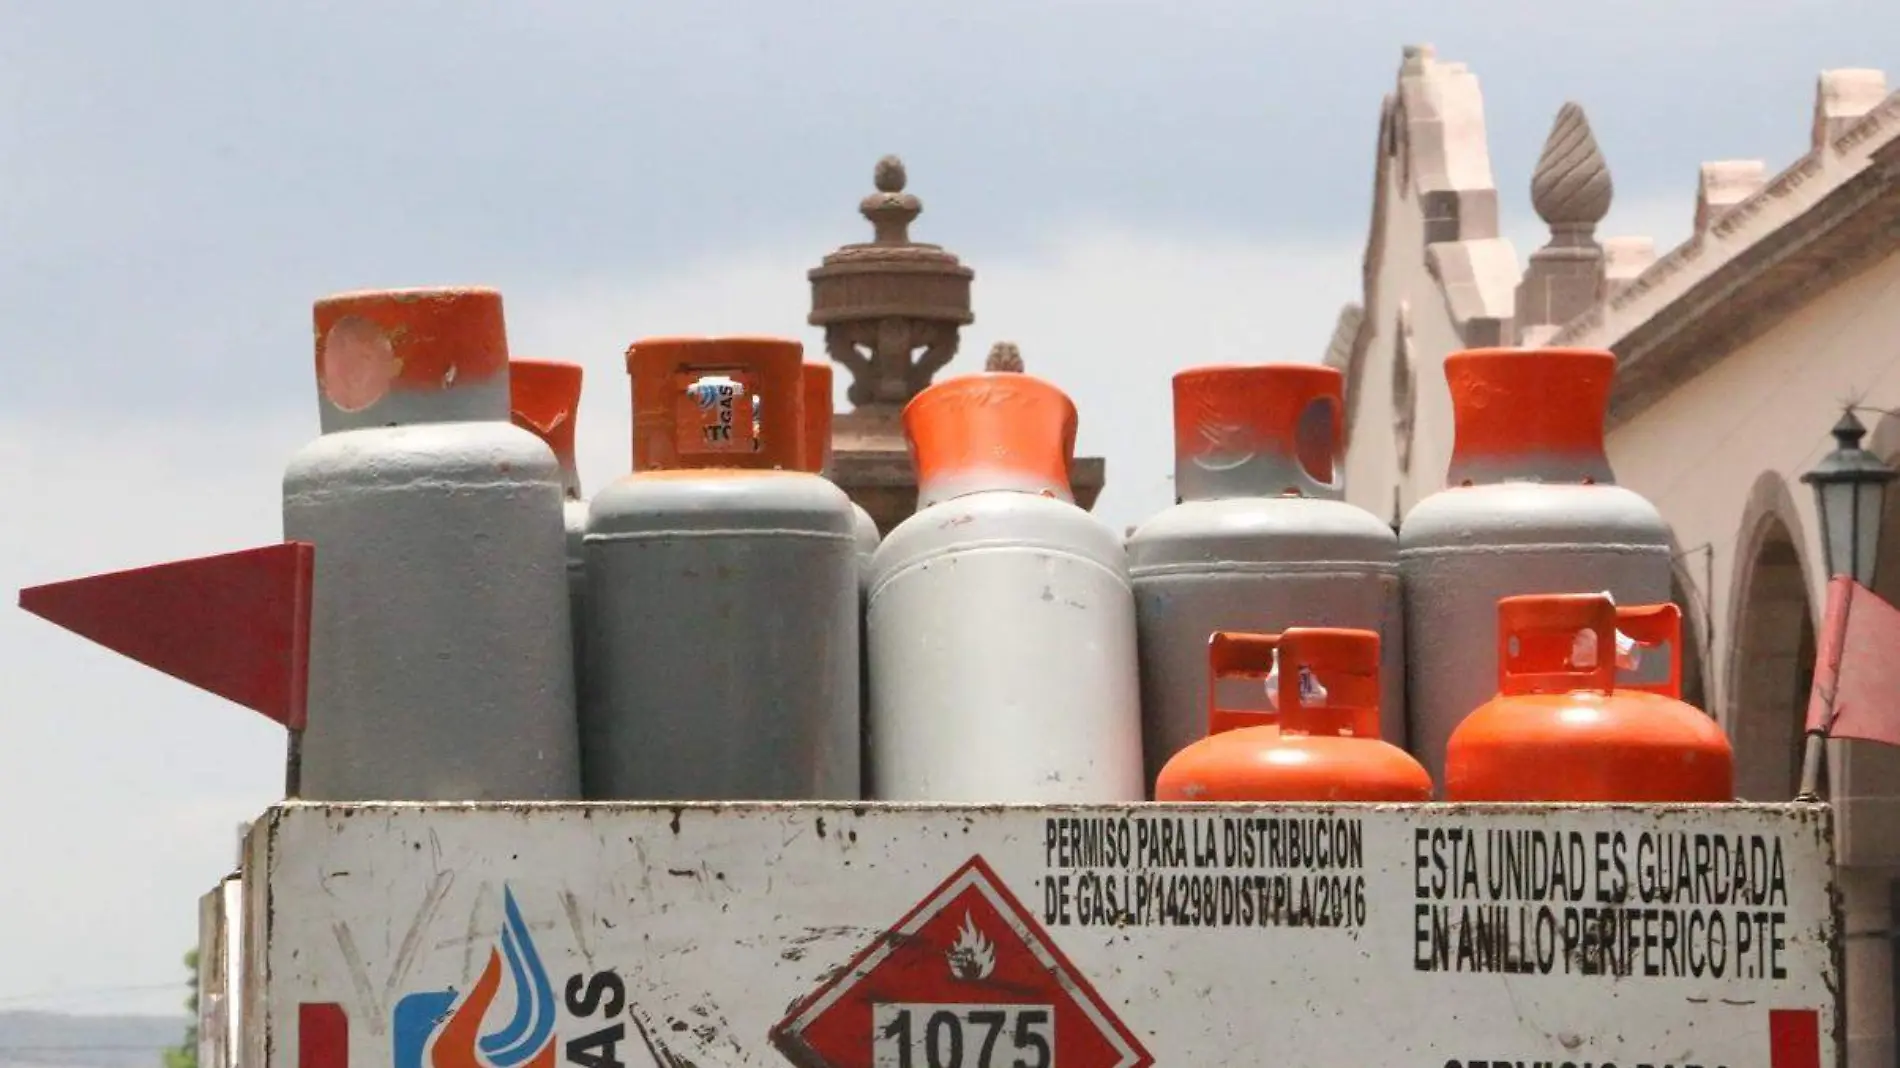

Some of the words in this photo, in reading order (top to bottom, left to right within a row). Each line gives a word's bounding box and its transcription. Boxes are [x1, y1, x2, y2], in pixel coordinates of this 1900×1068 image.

[1045, 817, 1131, 868] PERMISO
[1136, 818, 1187, 868] PARA
[1193, 818, 1218, 868] LA
[1223, 818, 1363, 868] DISTRIBUCION
[1415, 827, 1480, 900] ESTA
[1488, 829, 1586, 901] UNIDAD
[1595, 831, 1628, 904] ES
[1637, 831, 1787, 906] GUARDADA
[1045, 875, 1071, 925] DE
[1414, 903, 1449, 971] EN
[1456, 904, 1554, 974] ANILLO
[1564, 907, 1727, 978] PERIFERICO
[884, 1009, 1051, 1068] 1075
